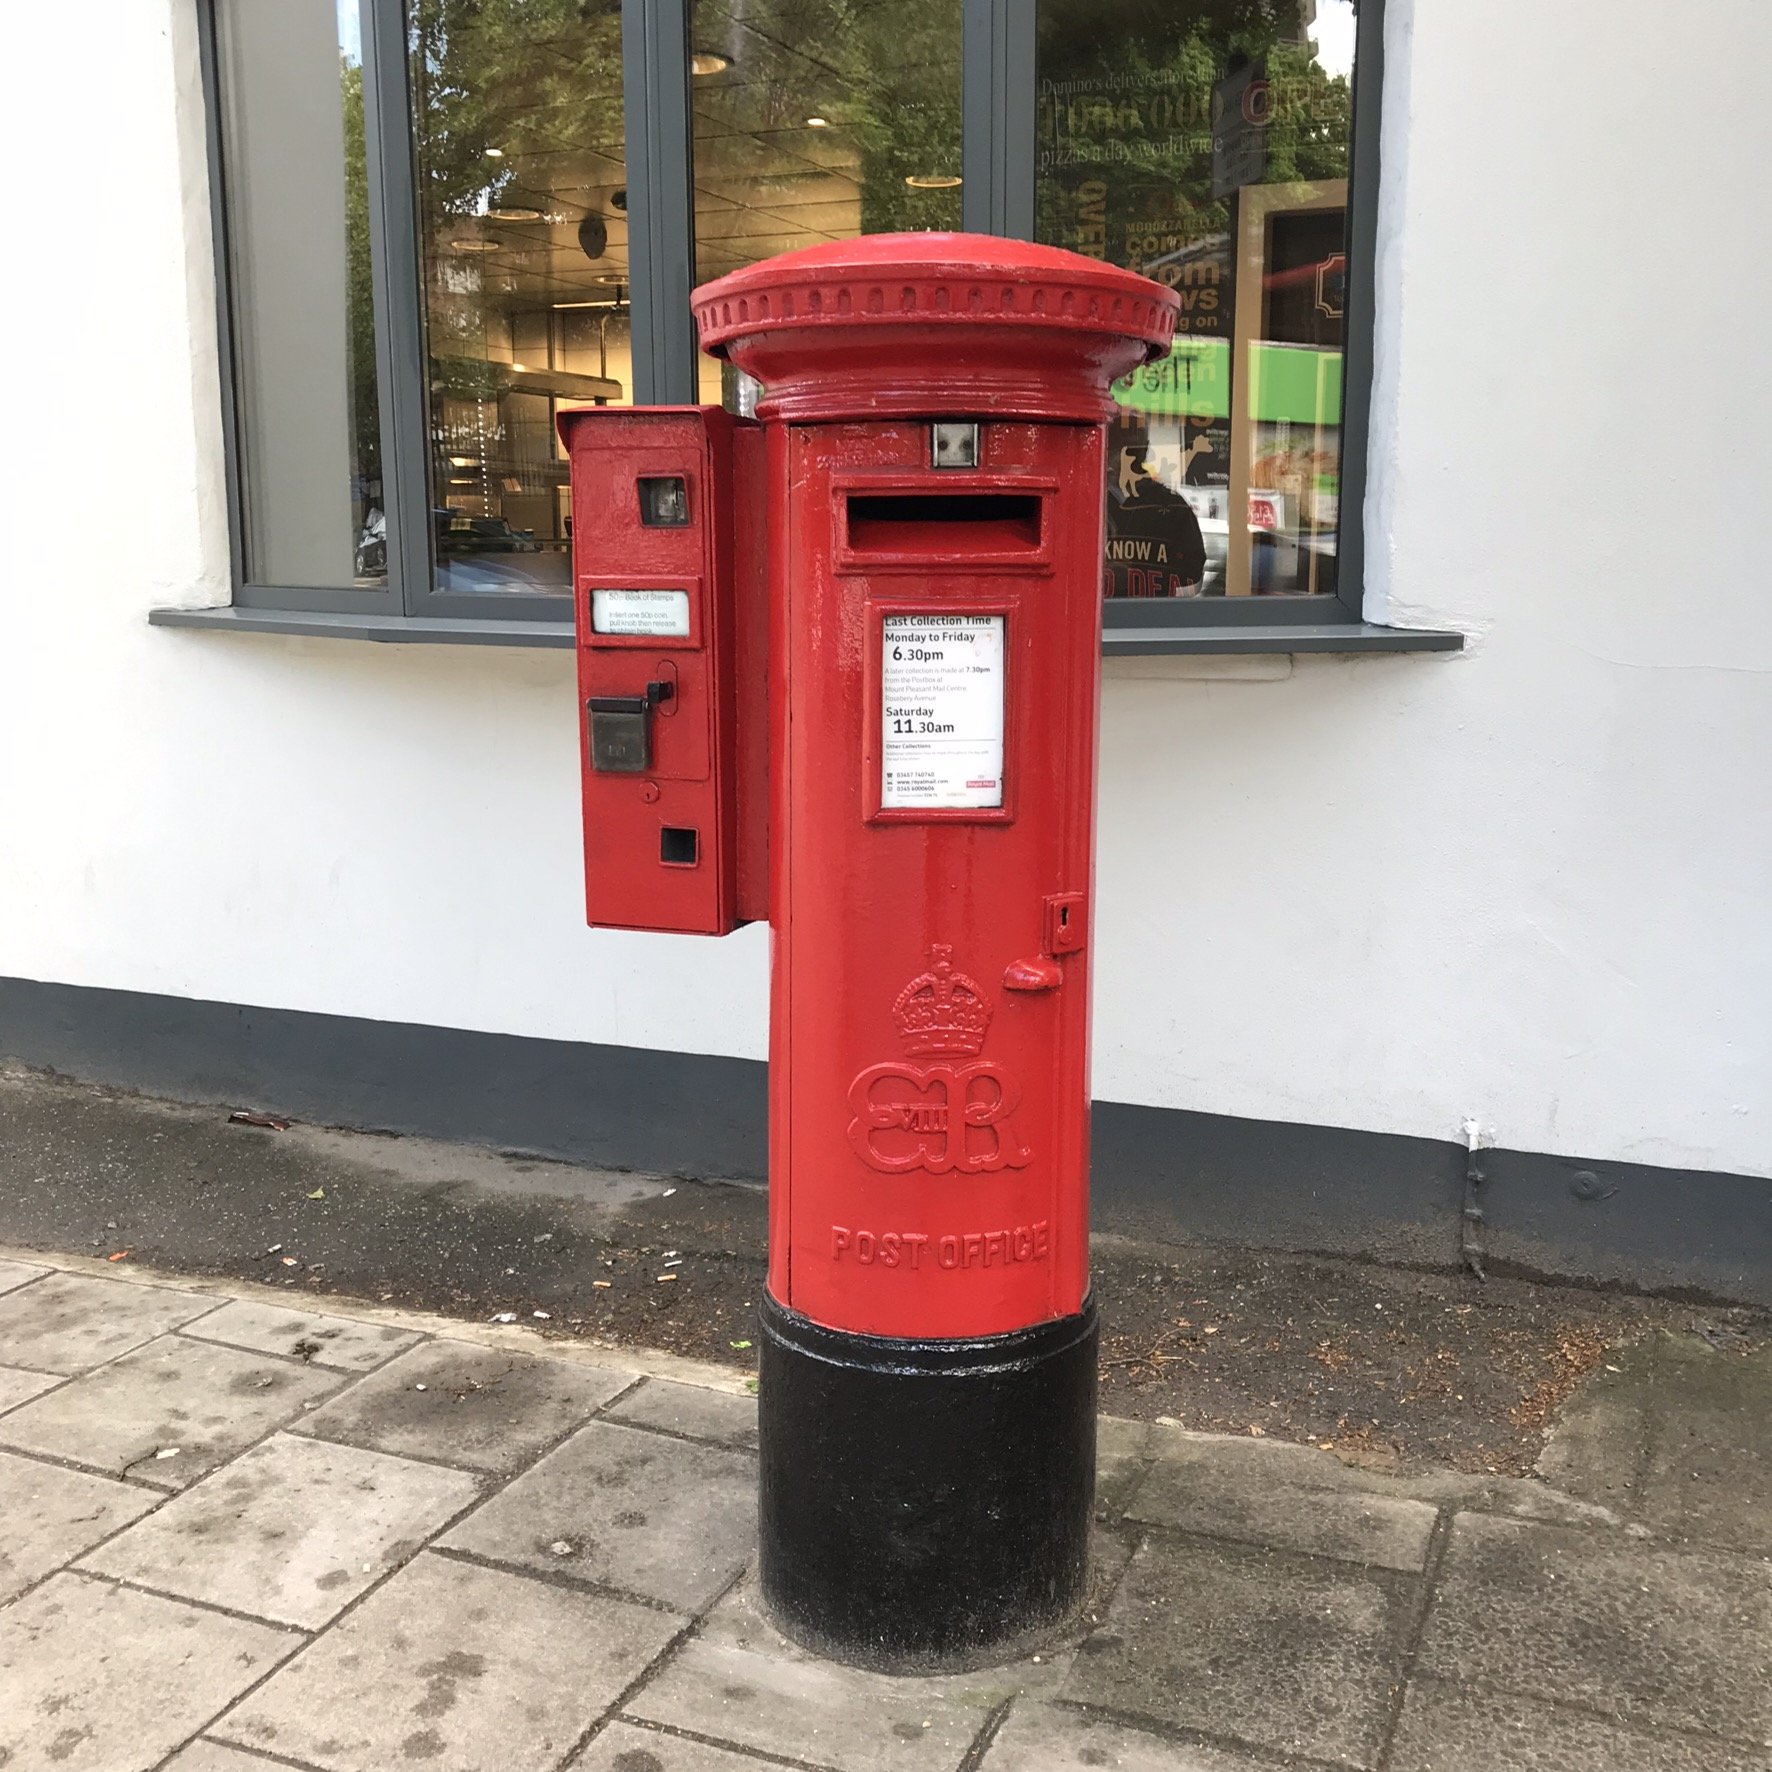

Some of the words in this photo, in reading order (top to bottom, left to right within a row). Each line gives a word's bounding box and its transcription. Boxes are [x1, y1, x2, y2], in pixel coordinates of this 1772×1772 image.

[1042, 76, 1101, 95] Domino's
[1105, 71, 1156, 90] delivers
[1040, 145, 1088, 171] pizzas
[1105, 138, 1131, 165] day
[1136, 134, 1224, 161] worldwide
[1196, 315, 1218, 328] on
[1121, 391, 1216, 429] hills
[1157, 543, 1168, 564] A
[625, 592, 641, 601] Book
[642, 592, 649, 601] of
[650, 592, 674, 602] Stamps
[621, 619, 637, 627] knob
[652, 620, 677, 628] release
[885, 616, 908, 627] Last
[910, 616, 962, 626] Collection
[965, 616, 991, 626] Time
[885, 632, 926, 644] Monday
[929, 632, 940, 642] to
[942, 631, 976, 644] Friday
[892, 646, 944, 663] 6.30pm
[966, 666, 991, 674] 7.30pm
[886, 706, 934, 718] Saturday
[893, 718, 954, 734] 11.30am
[832, 1225, 929, 1269] POST
[938, 1219, 1048, 1269] OFFICE
